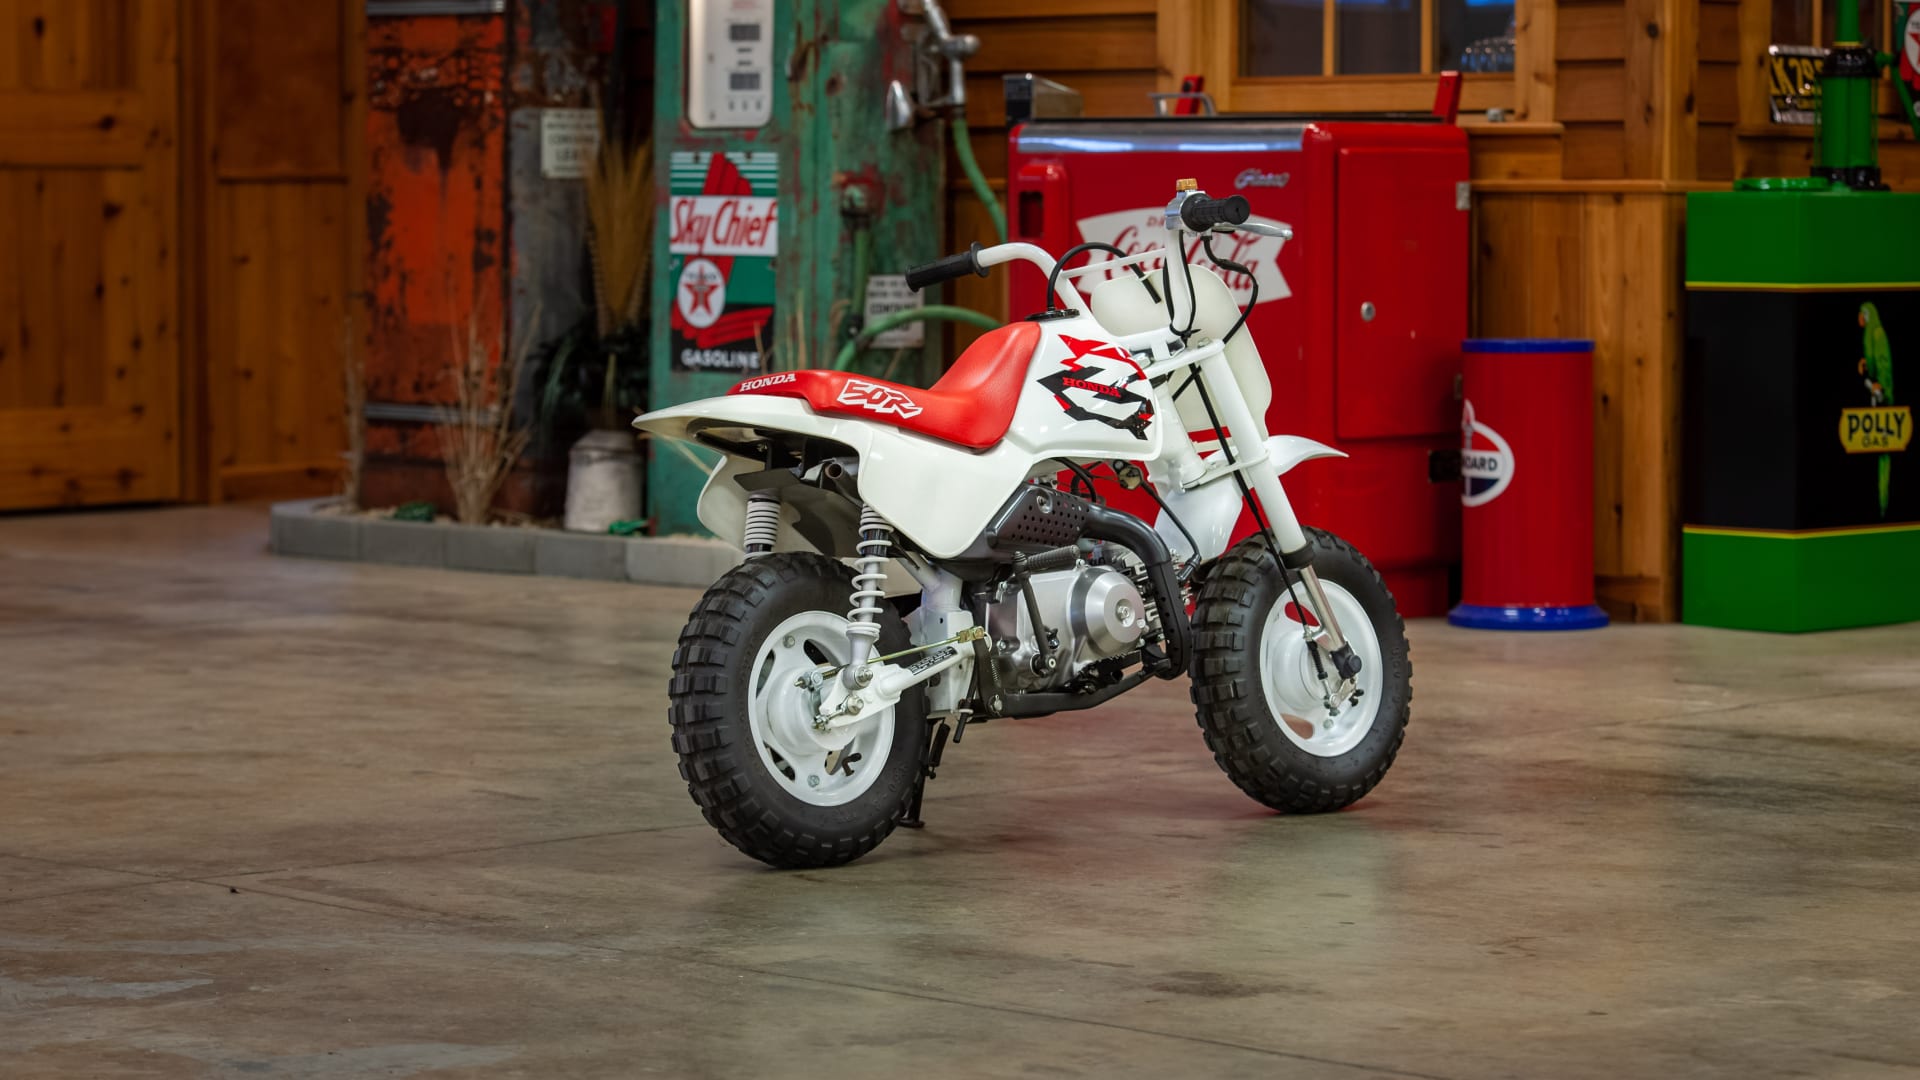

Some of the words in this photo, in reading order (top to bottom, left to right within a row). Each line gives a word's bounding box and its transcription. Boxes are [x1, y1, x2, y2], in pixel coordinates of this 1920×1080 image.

[670, 197, 712, 253] Sky
[712, 198, 778, 247] Chief
[681, 348, 760, 369] GASOLINE
[739, 373, 796, 393] HONDA
[1062, 376, 1122, 398] HONDA
[836, 379, 923, 419] 50R
[1847, 411, 1905, 442] POLLY
[1862, 434, 1889, 448] GAS
[1462, 455, 1498, 472] DARD
